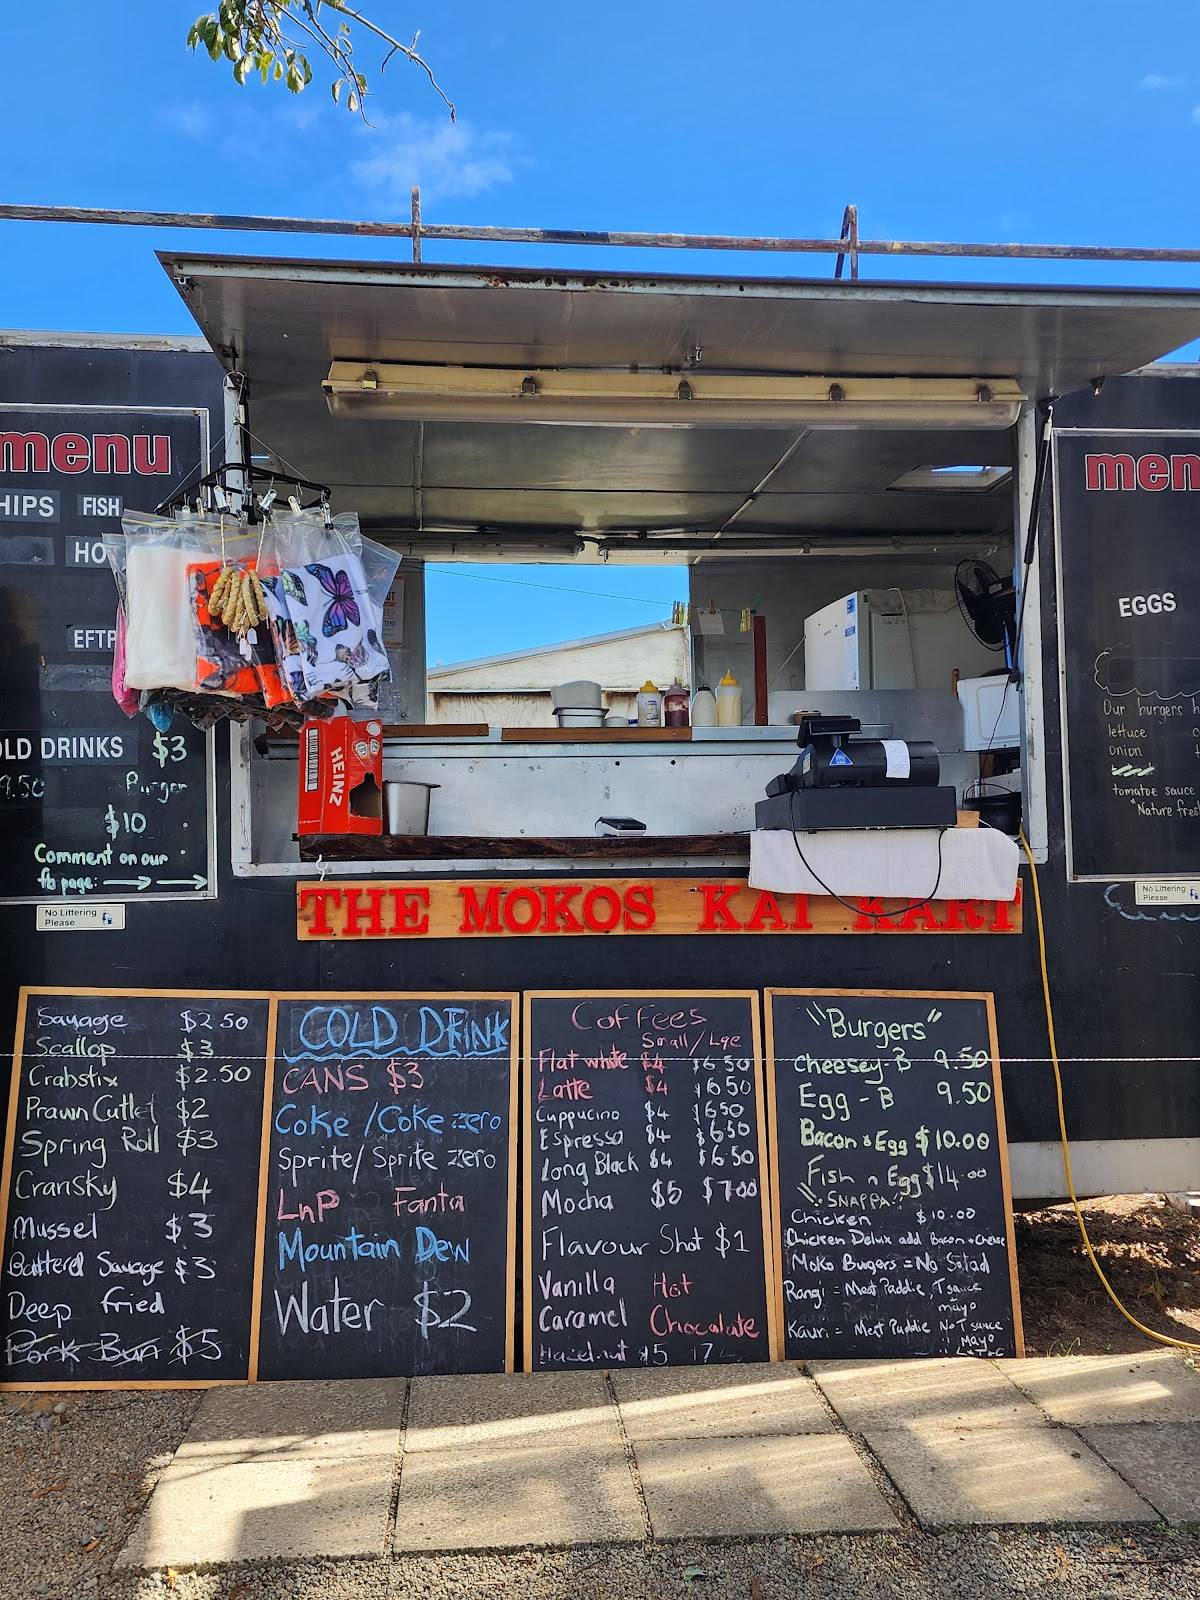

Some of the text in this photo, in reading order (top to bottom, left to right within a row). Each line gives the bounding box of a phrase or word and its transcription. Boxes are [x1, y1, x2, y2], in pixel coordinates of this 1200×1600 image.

[0, 432, 171, 475] menu
[83, 497, 120, 517] FISH
[1118, 592, 1177, 618] EGGS
[1104, 699, 1126, 716] Our
[1138, 697, 1184, 724] burgers
[1108, 723, 1148, 739] lettuce
[0, 731, 188, 768] LD DRINKS $3
[1109, 744, 1143, 757] onion
[329, 746, 346, 807] HEINZ
[1112, 783, 1197, 797] tomatoe sauce
[104, 804, 147, 841] $10
[34, 843, 169, 866] Comment on our
[37, 866, 57, 890] fb
[1155, 885, 1186, 893] Littering
[44, 908, 97, 918] No Littering
[44, 919, 76, 927] Please
[300, 883, 1022, 936] THE MOKOS KAI KART
[300, 1005, 399, 1050] COLD
[36, 1034, 214, 1066] Scallop $3
[538, 1048, 580, 1073] Flat
[640, 1051, 668, 1074] $4
[934, 1047, 989, 1071] 9.50
[28, 1064, 251, 1091] Crabstix $2.50
[282, 1059, 425, 1095] CANS $3
[536, 1076, 594, 1104] Latte
[644, 1074, 669, 1096] $4
[26, 1096, 89, 1121] Prawn
[176, 1097, 209, 1127] $2
[644, 1100, 672, 1123] $4
[799, 1080, 992, 1121] Egg B 9.50
[275, 1103, 350, 1138] Coke
[21, 1125, 218, 1168] Spring Roll $3
[539, 1127, 624, 1158] Espresso
[645, 1124, 672, 1144] $4
[800, 1118, 857, 1149] Bacon
[875, 1129, 909, 1157] Egg
[915, 1124, 990, 1157] $10.00
[372, 1141, 438, 1180] Sprite
[447, 1148, 497, 1170] zero
[541, 1156, 589, 1186] Long
[594, 1150, 640, 1177] Black
[649, 1148, 673, 1169] $4
[807, 1154, 855, 1187] Fish
[887, 1164, 922, 1198] Egg
[167, 1168, 213, 1205] $4
[541, 1188, 615, 1218] Mocha
[650, 1177, 684, 1209] $5
[277, 1182, 466, 1224] LnP Fanta
[791, 1206, 977, 1226] Chicken $10.00
[13, 1212, 214, 1243] Mussel $3
[541, 1219, 750, 1261] Flavour Shot $1
[785, 1228, 846, 1247] Chicken
[849, 1229, 893, 1246] Delux
[898, 1231, 922, 1246] add
[278, 1226, 402, 1273] Mountain
[792, 1252, 835, 1273] Moko
[915, 1252, 939, 1274] No
[946, 1252, 991, 1275] Salad
[174, 1256, 217, 1284] $3
[538, 1268, 696, 1300] Vanilla Hot
[8, 1291, 72, 1328] Deep
[274, 1276, 477, 1340] Water $2
[783, 1280, 826, 1309] Rangi
[845, 1280, 877, 1297] Meat
[938, 1302, 977, 1317] mayo
[538, 1297, 761, 1339] Caramel Chocolate
[168, 1325, 222, 1364] $5
[961, 1333, 995, 1349] Mayo
